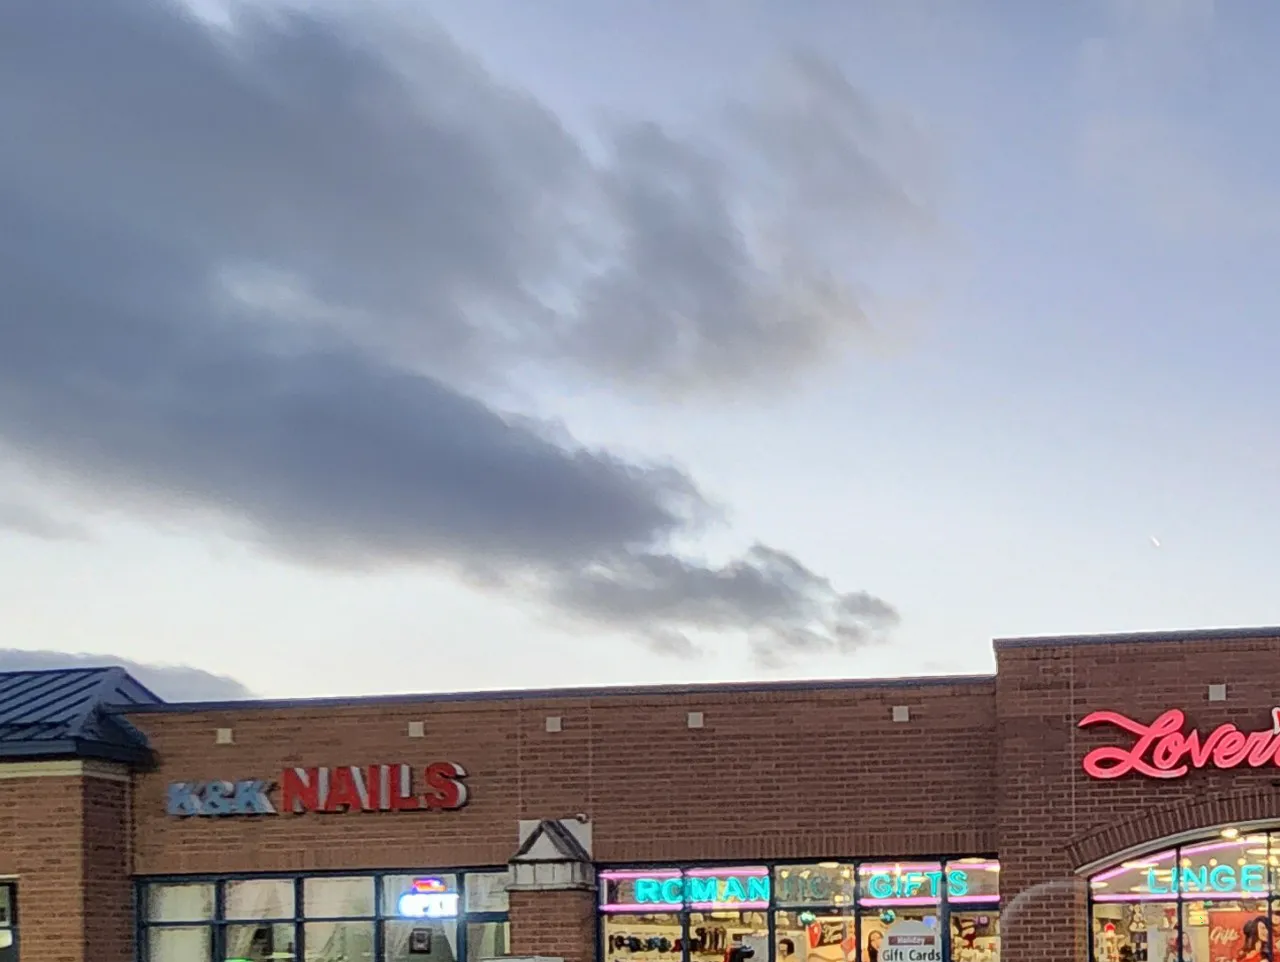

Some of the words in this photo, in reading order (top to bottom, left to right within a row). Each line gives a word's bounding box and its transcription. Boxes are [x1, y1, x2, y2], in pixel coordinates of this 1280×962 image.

[166, 780, 278, 816] K&K
[282, 762, 468, 814] NAILS
[868, 870, 968, 899] GIFTS
[882, 948, 904, 962] Gift
[908, 948, 942, 962] Cards
